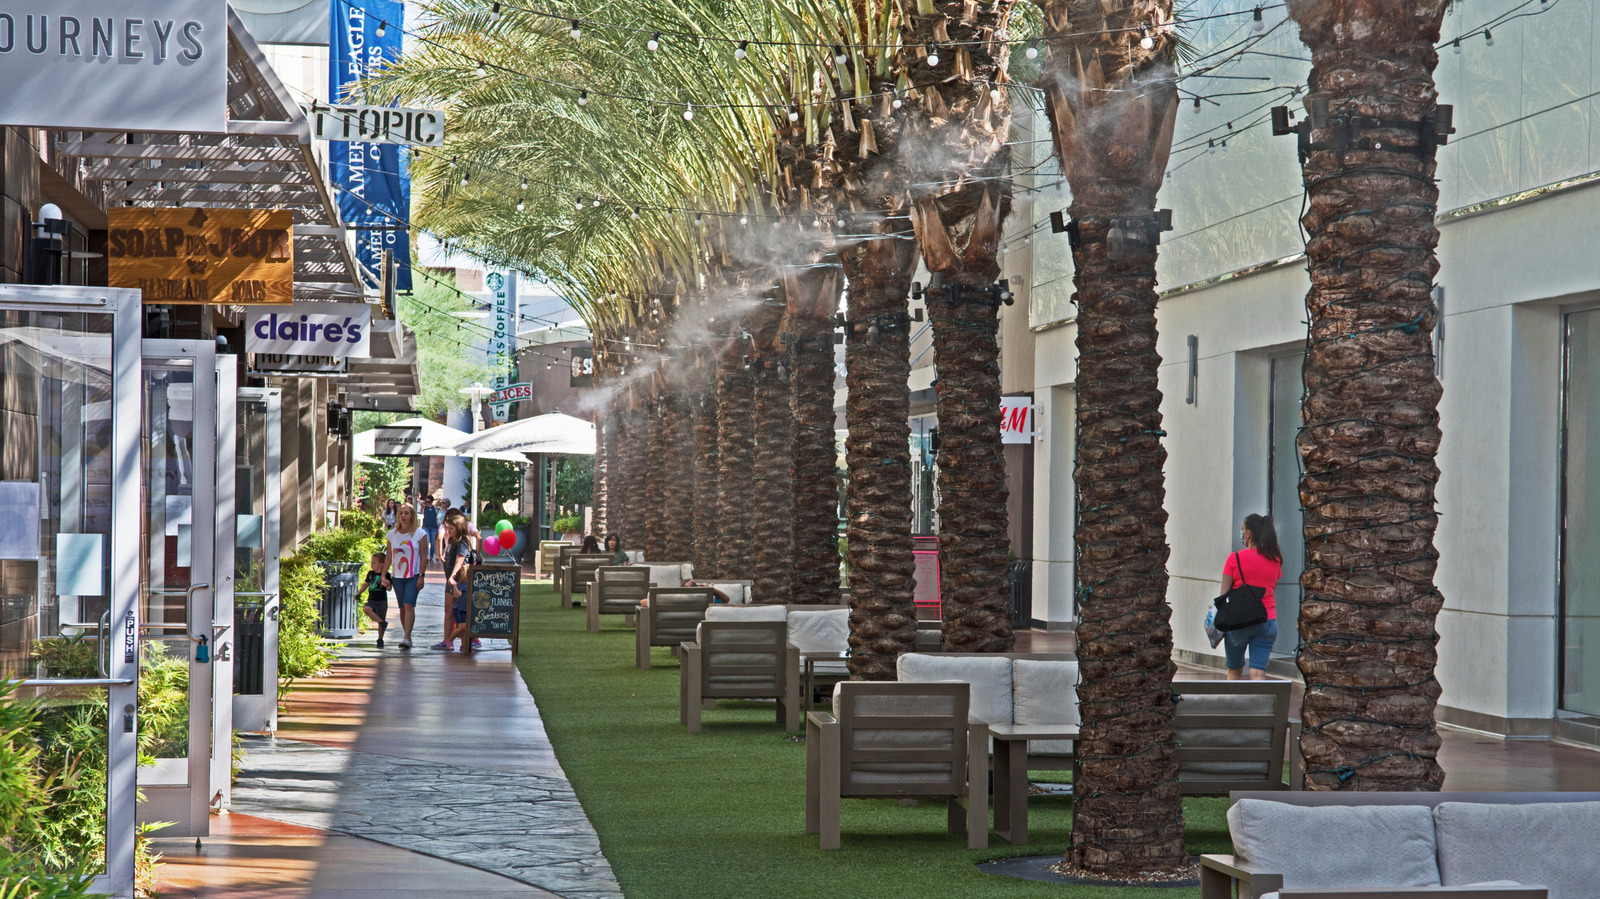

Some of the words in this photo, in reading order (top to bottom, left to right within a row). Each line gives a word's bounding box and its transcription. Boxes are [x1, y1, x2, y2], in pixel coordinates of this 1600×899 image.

[348, 7, 365, 75] EAGLE
[336, 108, 436, 142] TOPIC
[109, 227, 185, 258] SOAP
[209, 227, 291, 263] JOUR
[138, 278, 208, 300] HANDMADE
[231, 279, 267, 300] SOAPS
[254, 313, 362, 343] claire's
[496, 291, 506, 339] COFFEE
[489, 385, 531, 403] SLICES
[491, 597, 514, 607] FLANNEL
[126, 619, 134, 653] PUSH
